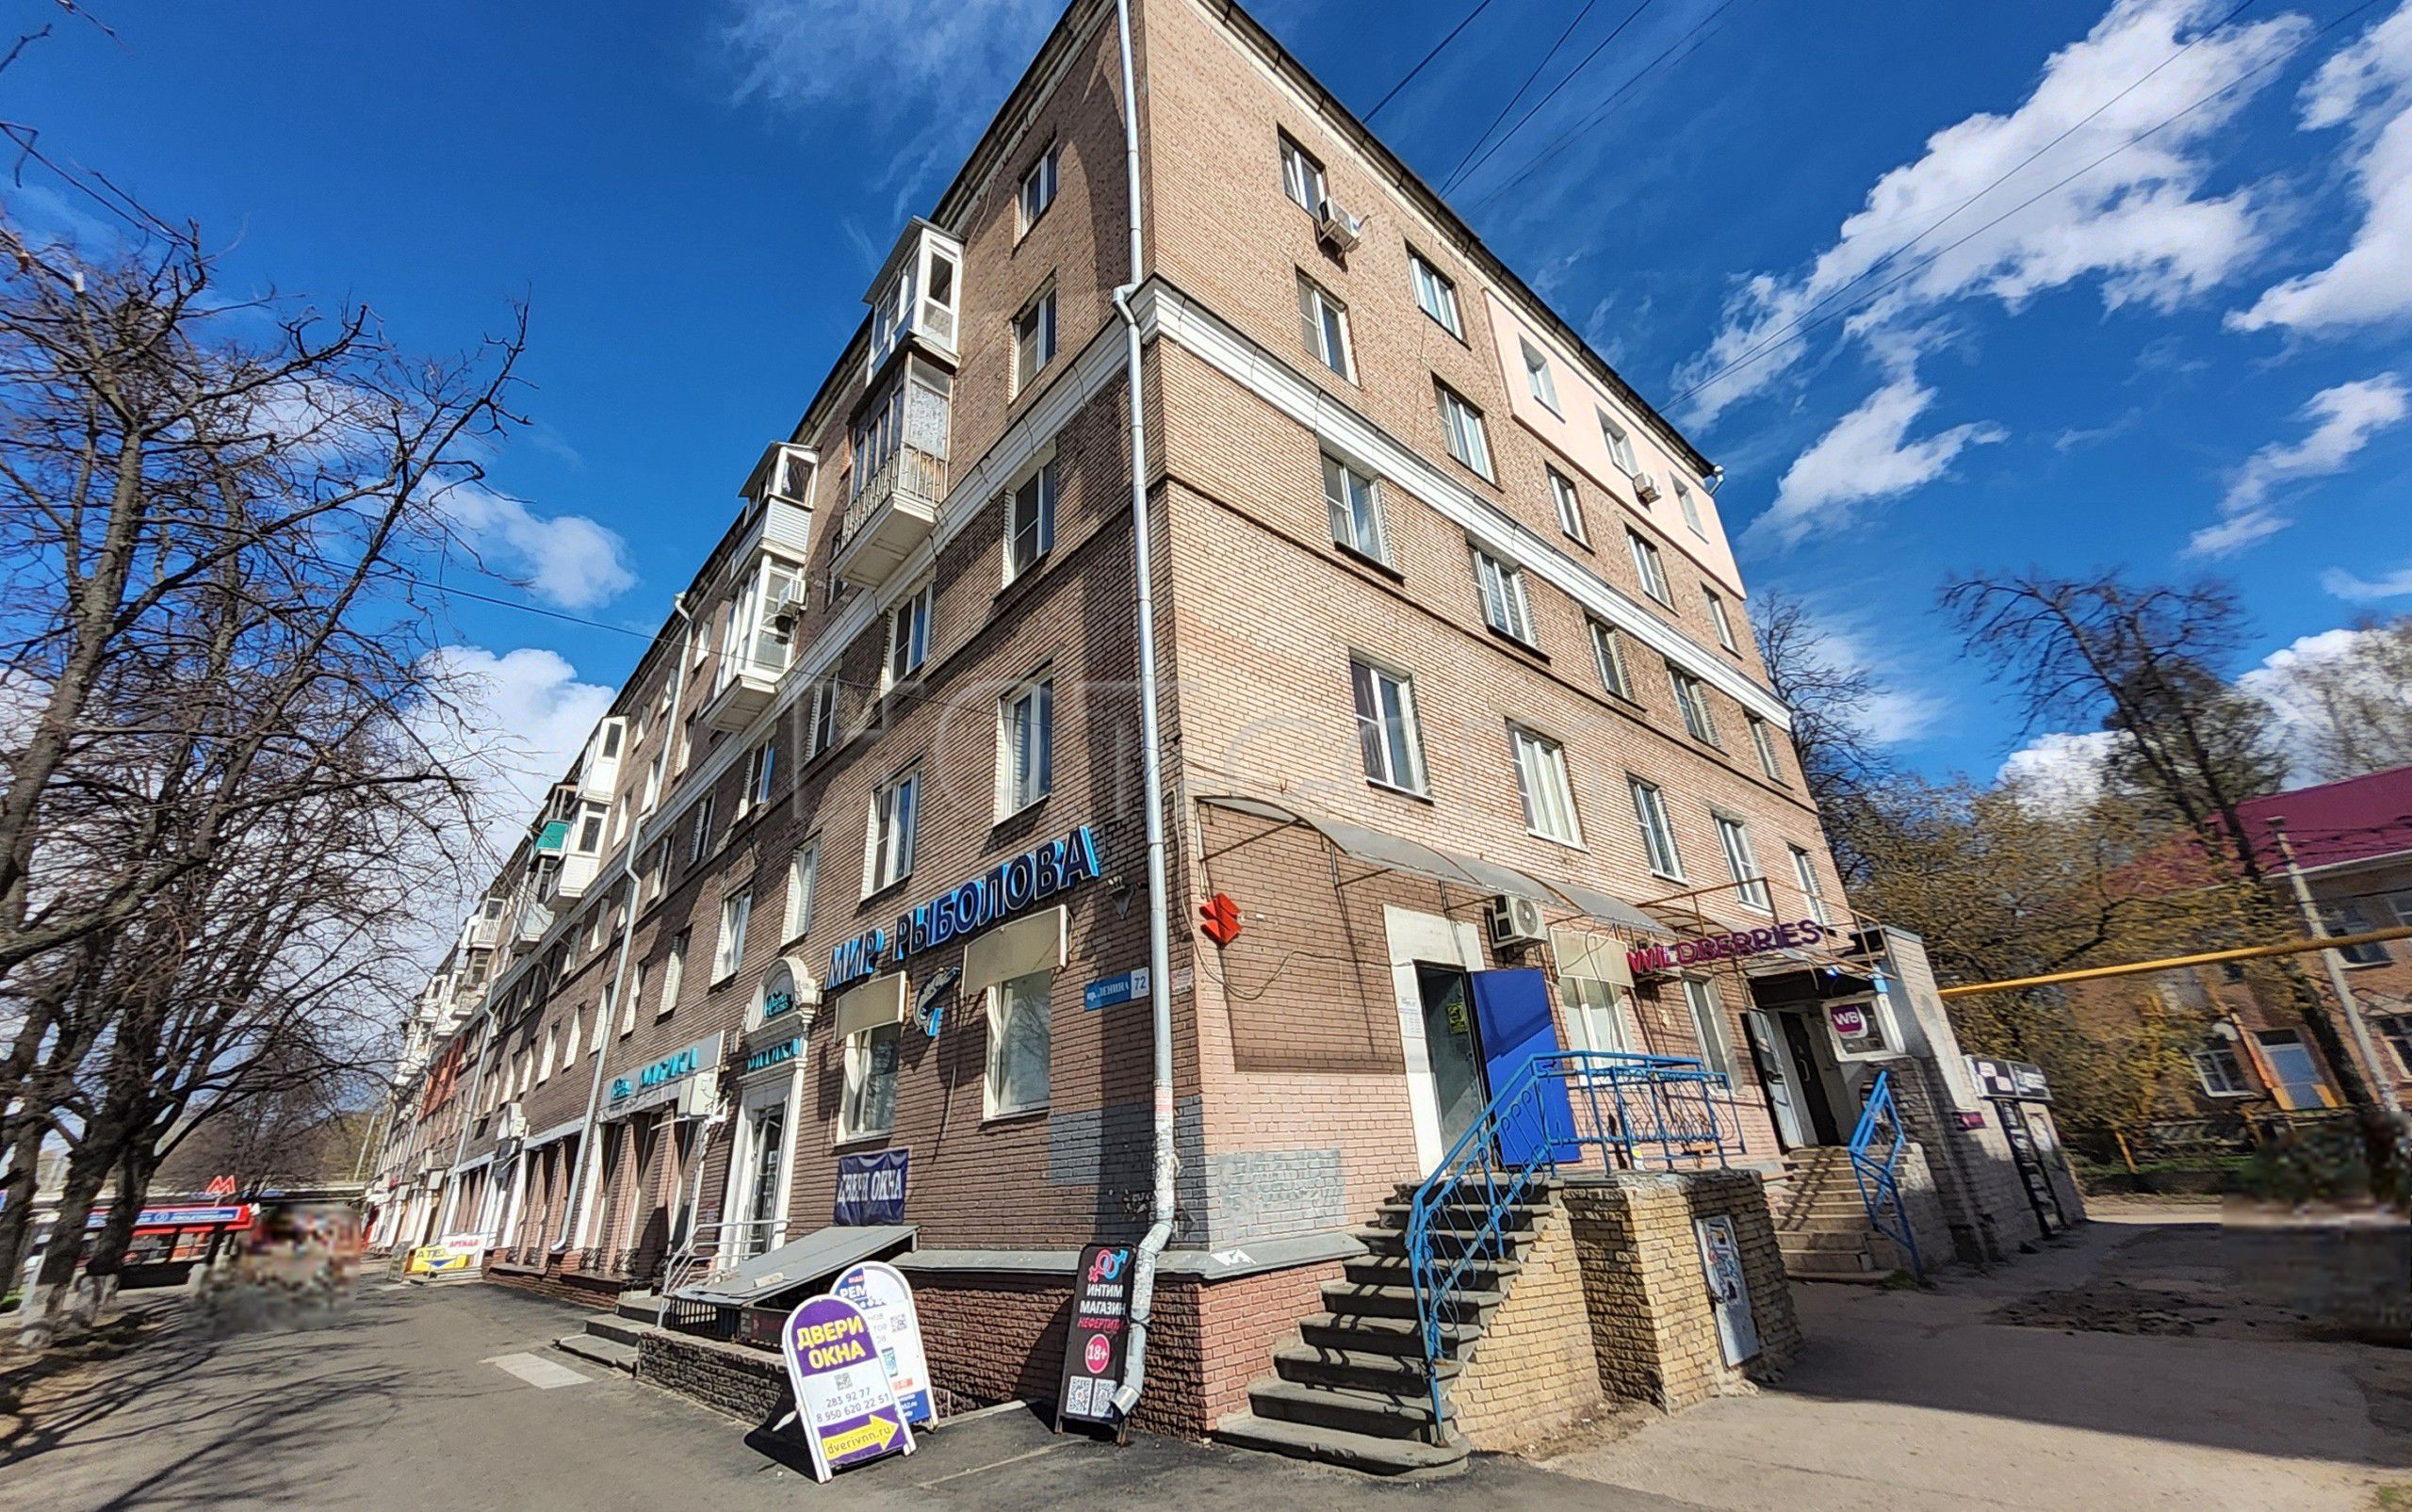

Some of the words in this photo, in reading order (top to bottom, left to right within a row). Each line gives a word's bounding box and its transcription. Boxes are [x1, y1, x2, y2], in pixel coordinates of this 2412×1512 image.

[824, 928, 885, 990] МИР
[892, 825, 1100, 962] РЫБОЛОВА
[1626, 919, 1820, 973] WILDBERRIES
[1100, 981, 1130, 998] ЛЕНИНА
[1133, 976, 1147, 990] 72
[1833, 1011, 1859, 1025] WB
[837, 1172, 871, 1206] ДВЕРИ
[871, 1168, 903, 1201] ОКНА
[1086, 1284, 1123, 1297] ИНТИМ
[1080, 1301, 1126, 1315] МАГАЗИН
[796, 1315, 864, 1351] ДВЕРИ
[808, 1339, 866, 1369] ОКНА
[1087, 1343, 1107, 1360] 18+
[816, 1413, 823, 1423] 8
[824, 1409, 841, 1421] 950
[844, 1403, 861, 1415] 620
[863, 1398, 875, 1409] 22
[878, 1393, 889, 1404] 51
[825, 1398, 843, 1407] 283
[845, 1391, 857, 1402] 92
[859, 1387, 871, 1398] 77
[827, 1425, 891, 1455] dverivnn.ru
